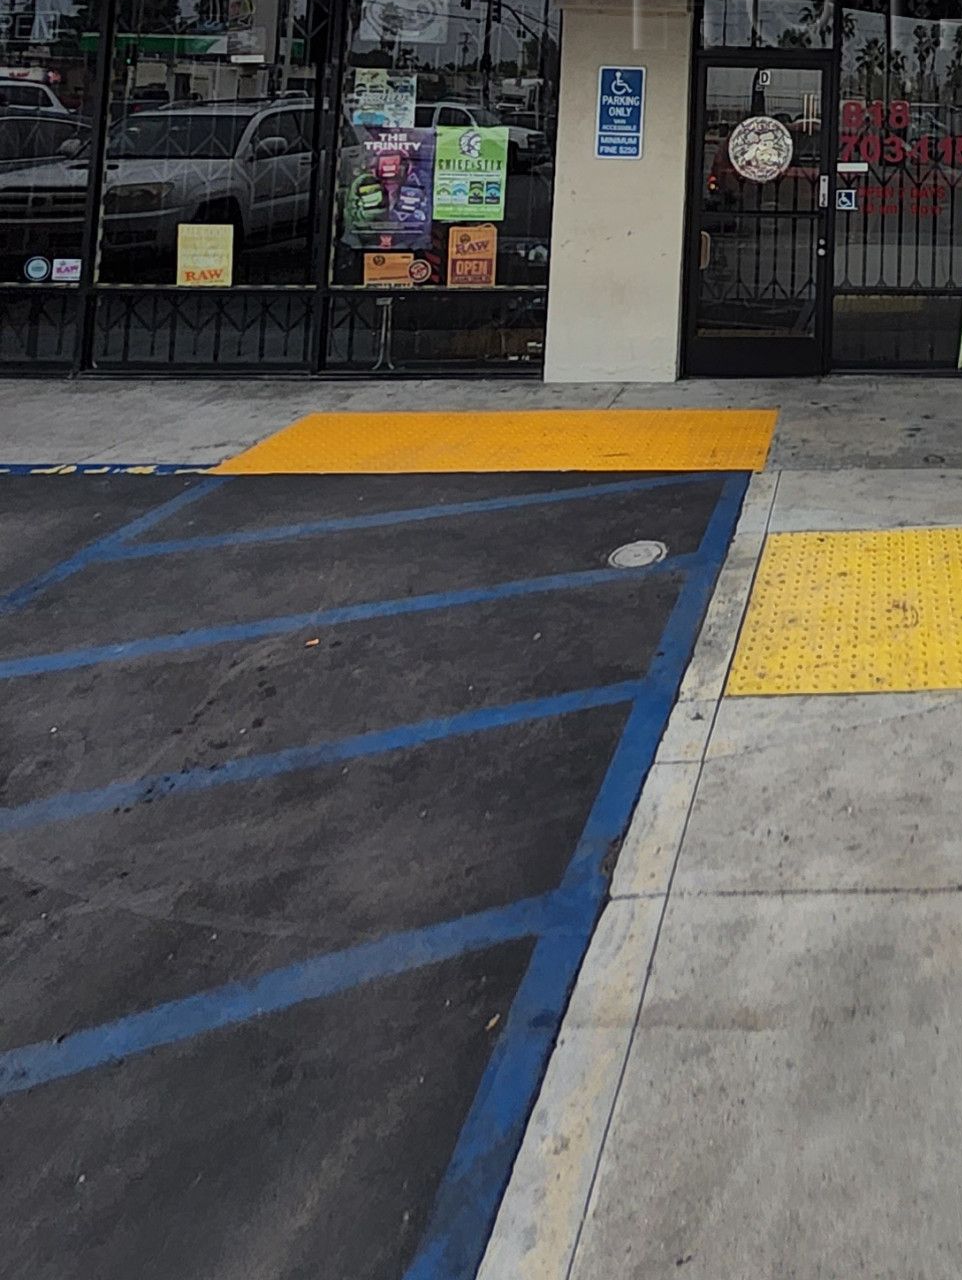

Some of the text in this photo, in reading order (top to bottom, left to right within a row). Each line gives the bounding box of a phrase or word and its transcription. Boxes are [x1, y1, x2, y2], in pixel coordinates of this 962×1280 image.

[760, 71, 769, 83] D
[602, 95, 640, 107] PARKING
[608, 106, 633, 118] ONLY
[842, 100, 911, 130] 818
[379, 133, 408, 142] THE
[600, 136, 638, 145] MINIMUM
[364, 141, 421, 151] TRINITY
[599, 146, 618, 155] FINE
[455, 239, 490, 256] RAW
[455, 260, 489, 276] OPEN
[184, 268, 225, 283] RAW
